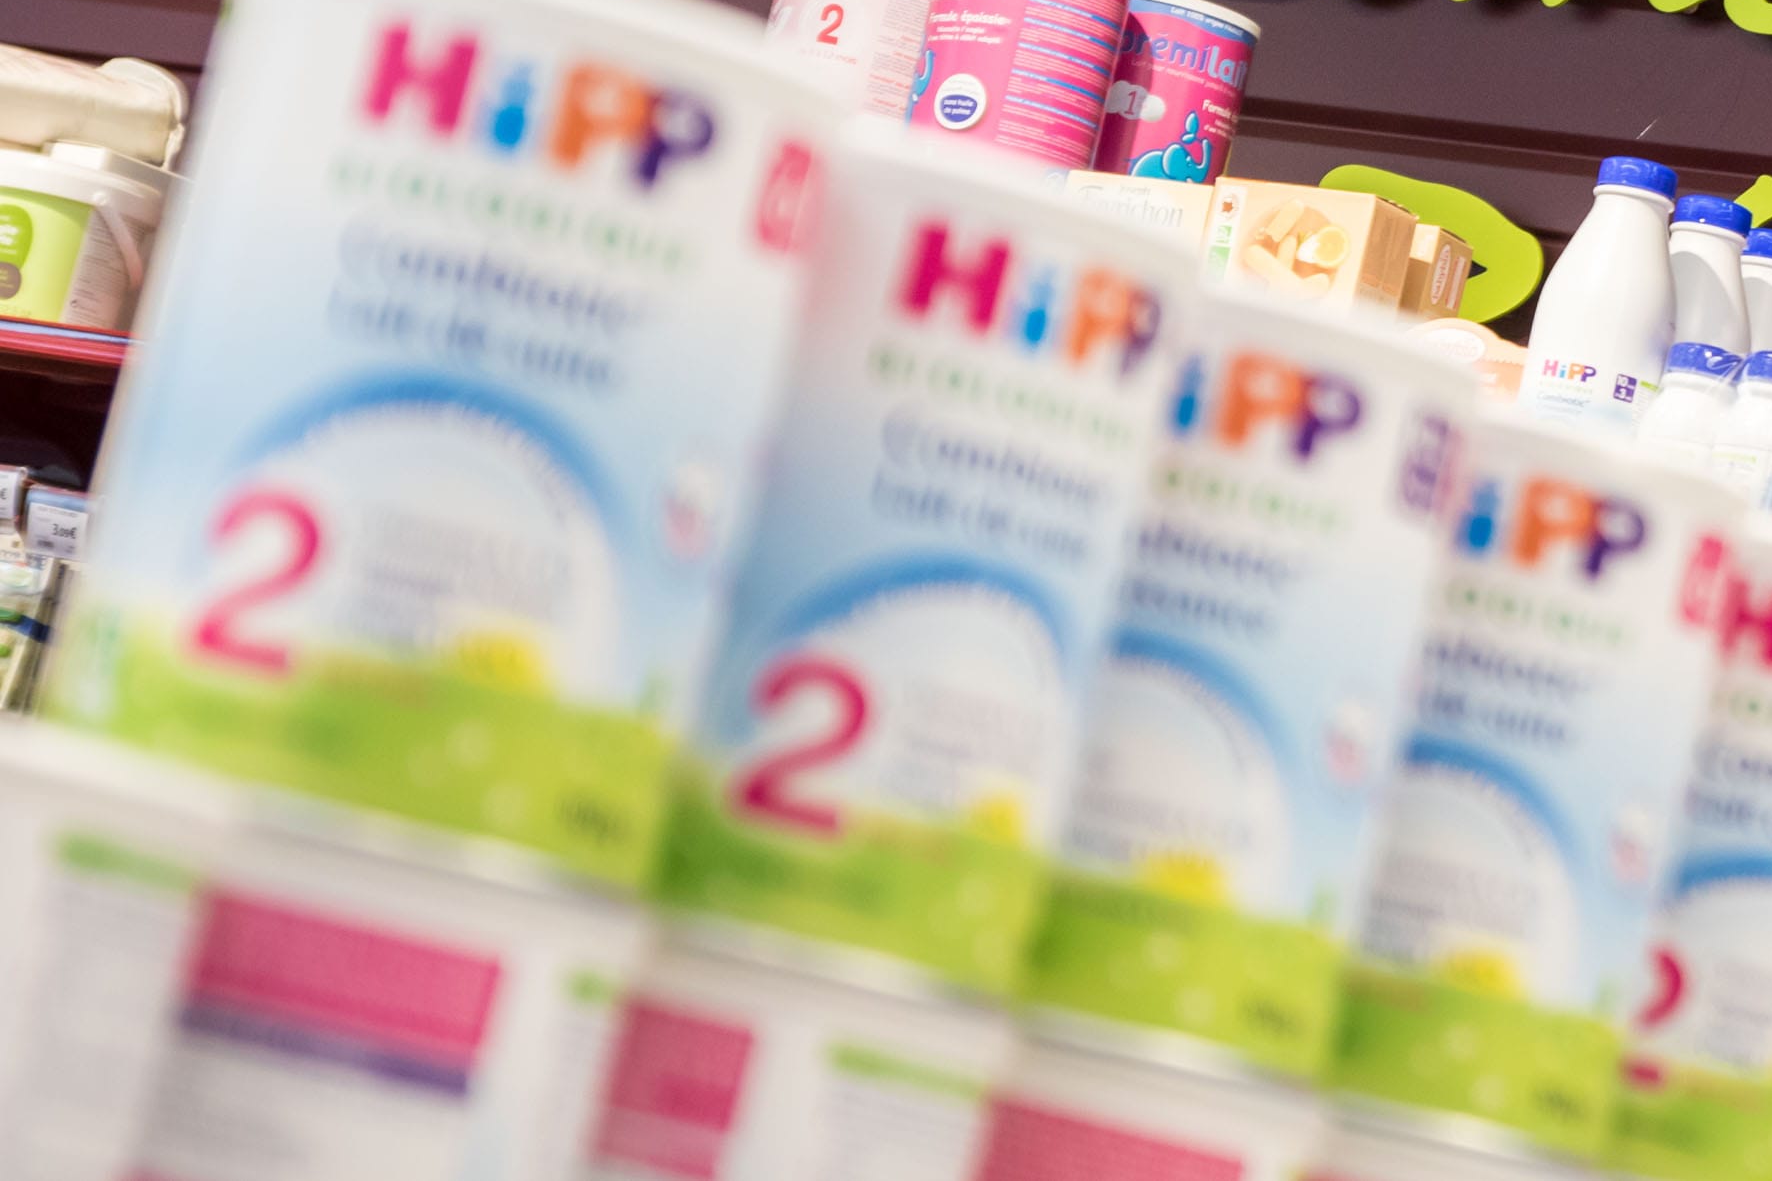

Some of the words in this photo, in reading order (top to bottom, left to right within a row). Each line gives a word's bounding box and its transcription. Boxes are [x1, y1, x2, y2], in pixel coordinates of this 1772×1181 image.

[816, 3, 845, 46] 2
[364, 19, 715, 187] HiPP
[1124, 90, 1138, 116] 1
[901, 219, 1161, 377] HiPP
[1168, 352, 1364, 462] iPP
[1542, 359, 1597, 382] HiPP
[193, 483, 323, 678] 2
[1456, 476, 1648, 581] iPP
[732, 653, 872, 840] 2
